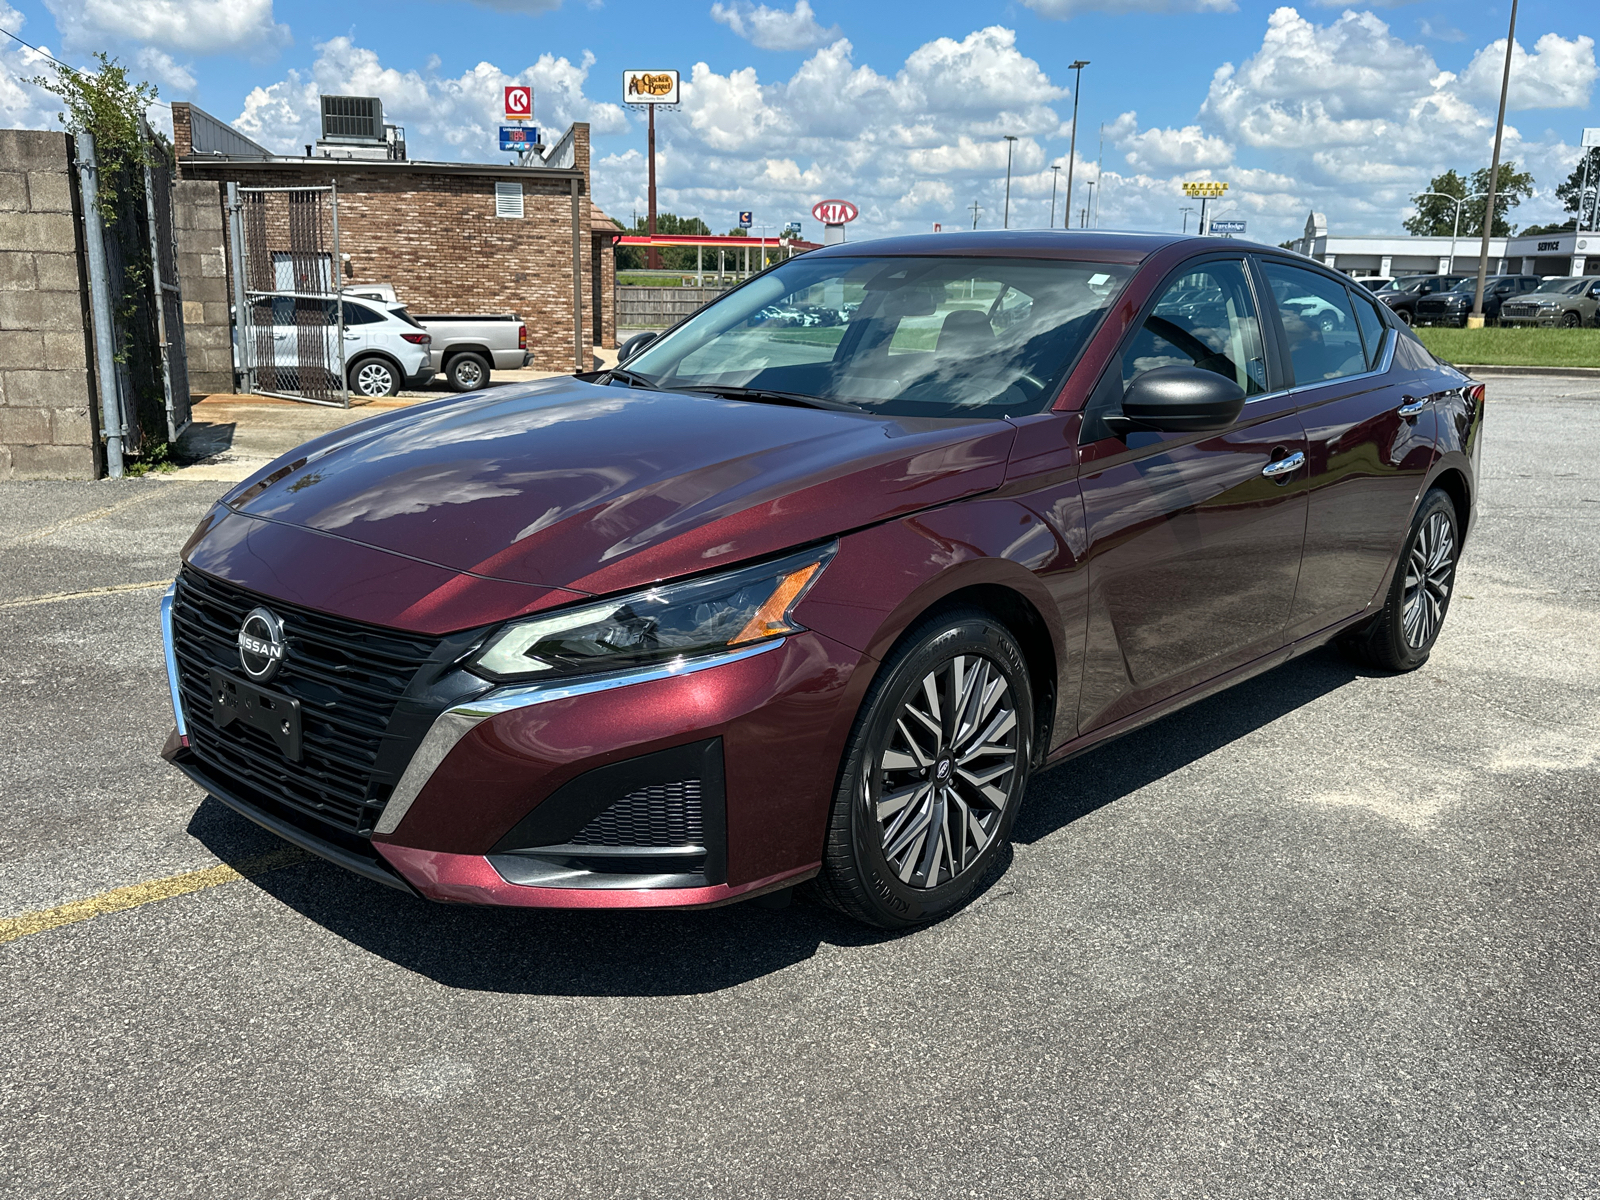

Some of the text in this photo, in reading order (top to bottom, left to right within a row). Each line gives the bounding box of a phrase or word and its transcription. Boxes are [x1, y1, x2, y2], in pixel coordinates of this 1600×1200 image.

[648, 82, 671, 95] Barrel
[1182, 182, 1229, 190] WAFFLE
[820, 205, 849, 222] KIA
[1537, 241, 1560, 251] SERVICE
[239, 632, 282, 658] NISSAN
